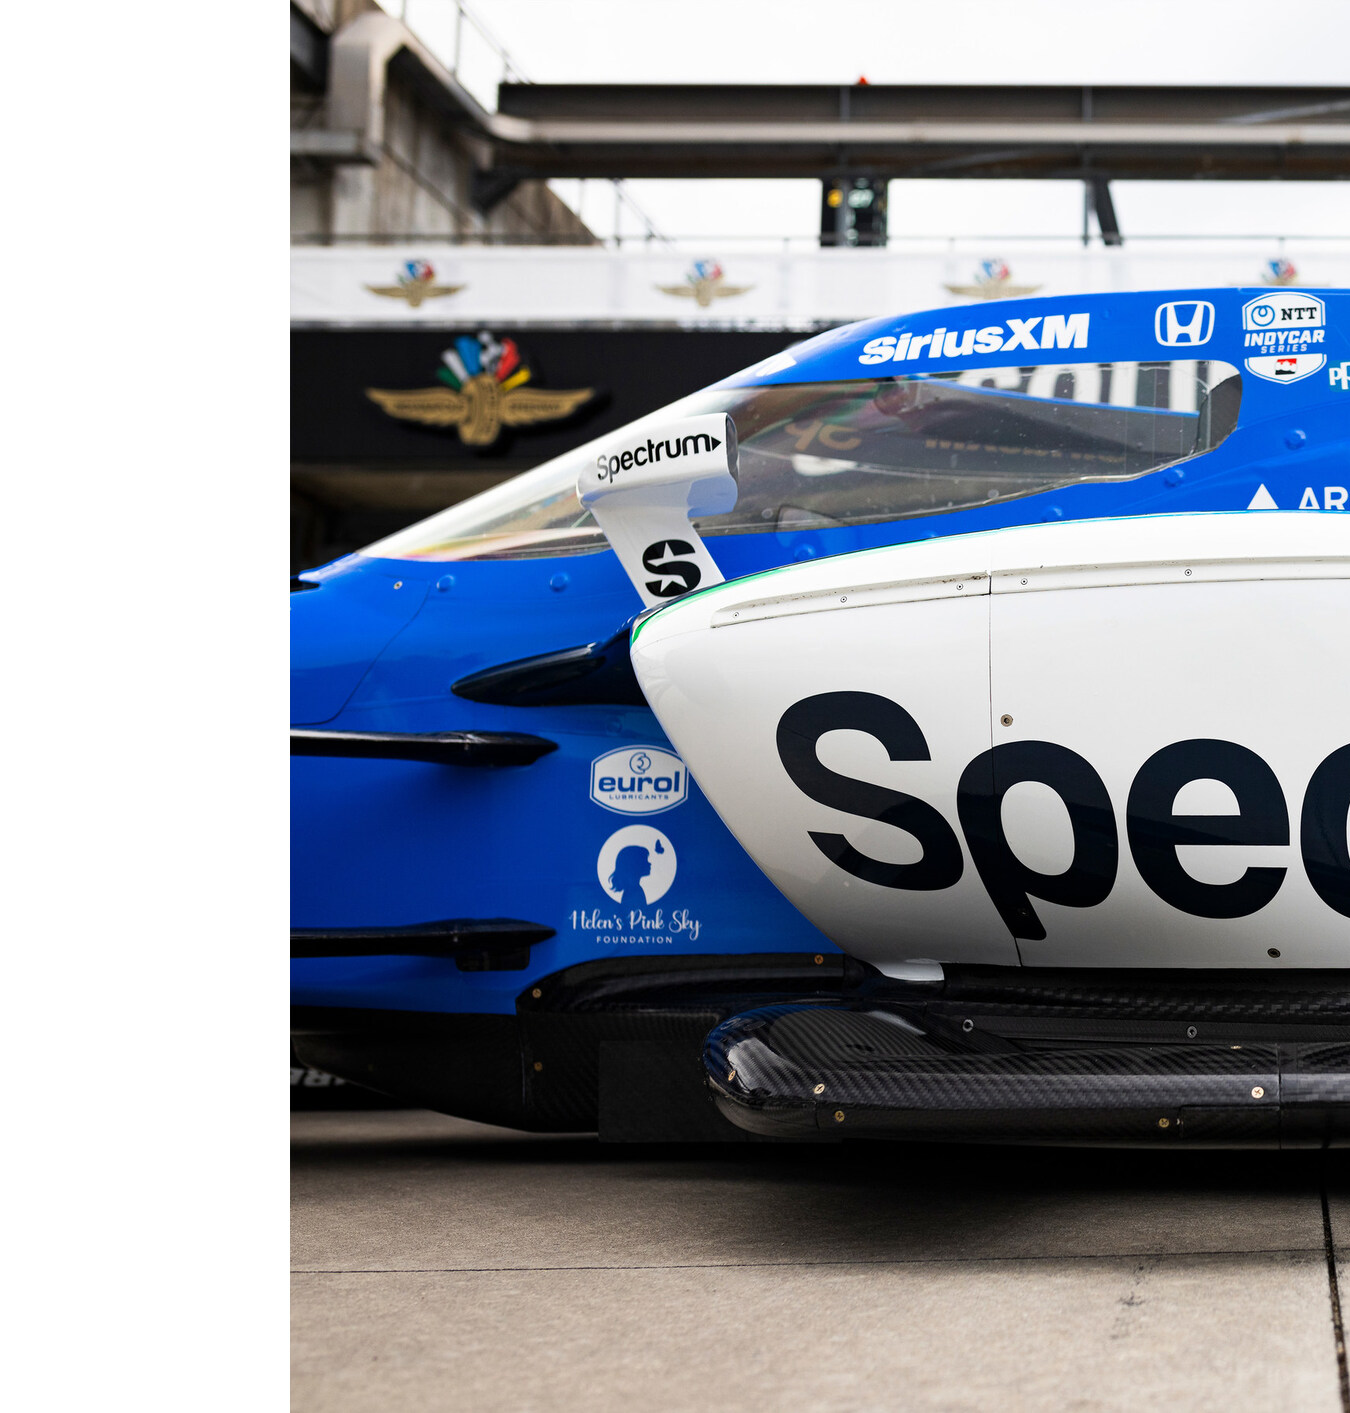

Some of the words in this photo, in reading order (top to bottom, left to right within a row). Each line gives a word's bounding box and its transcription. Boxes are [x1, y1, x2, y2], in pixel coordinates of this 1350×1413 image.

[1281, 307, 1317, 321] NTT
[858, 313, 1090, 365] SiriusXM
[1244, 329, 1325, 347] INDYCAR
[1261, 344, 1308, 354] SERIES
[597, 433, 711, 484] Spectrum
[598, 771, 680, 793] eurol
[569, 908, 623, 931] Helen's
[628, 909, 665, 931] Pink
[669, 909, 702, 941] Sky
[597, 936, 673, 944] FOUNDATION
